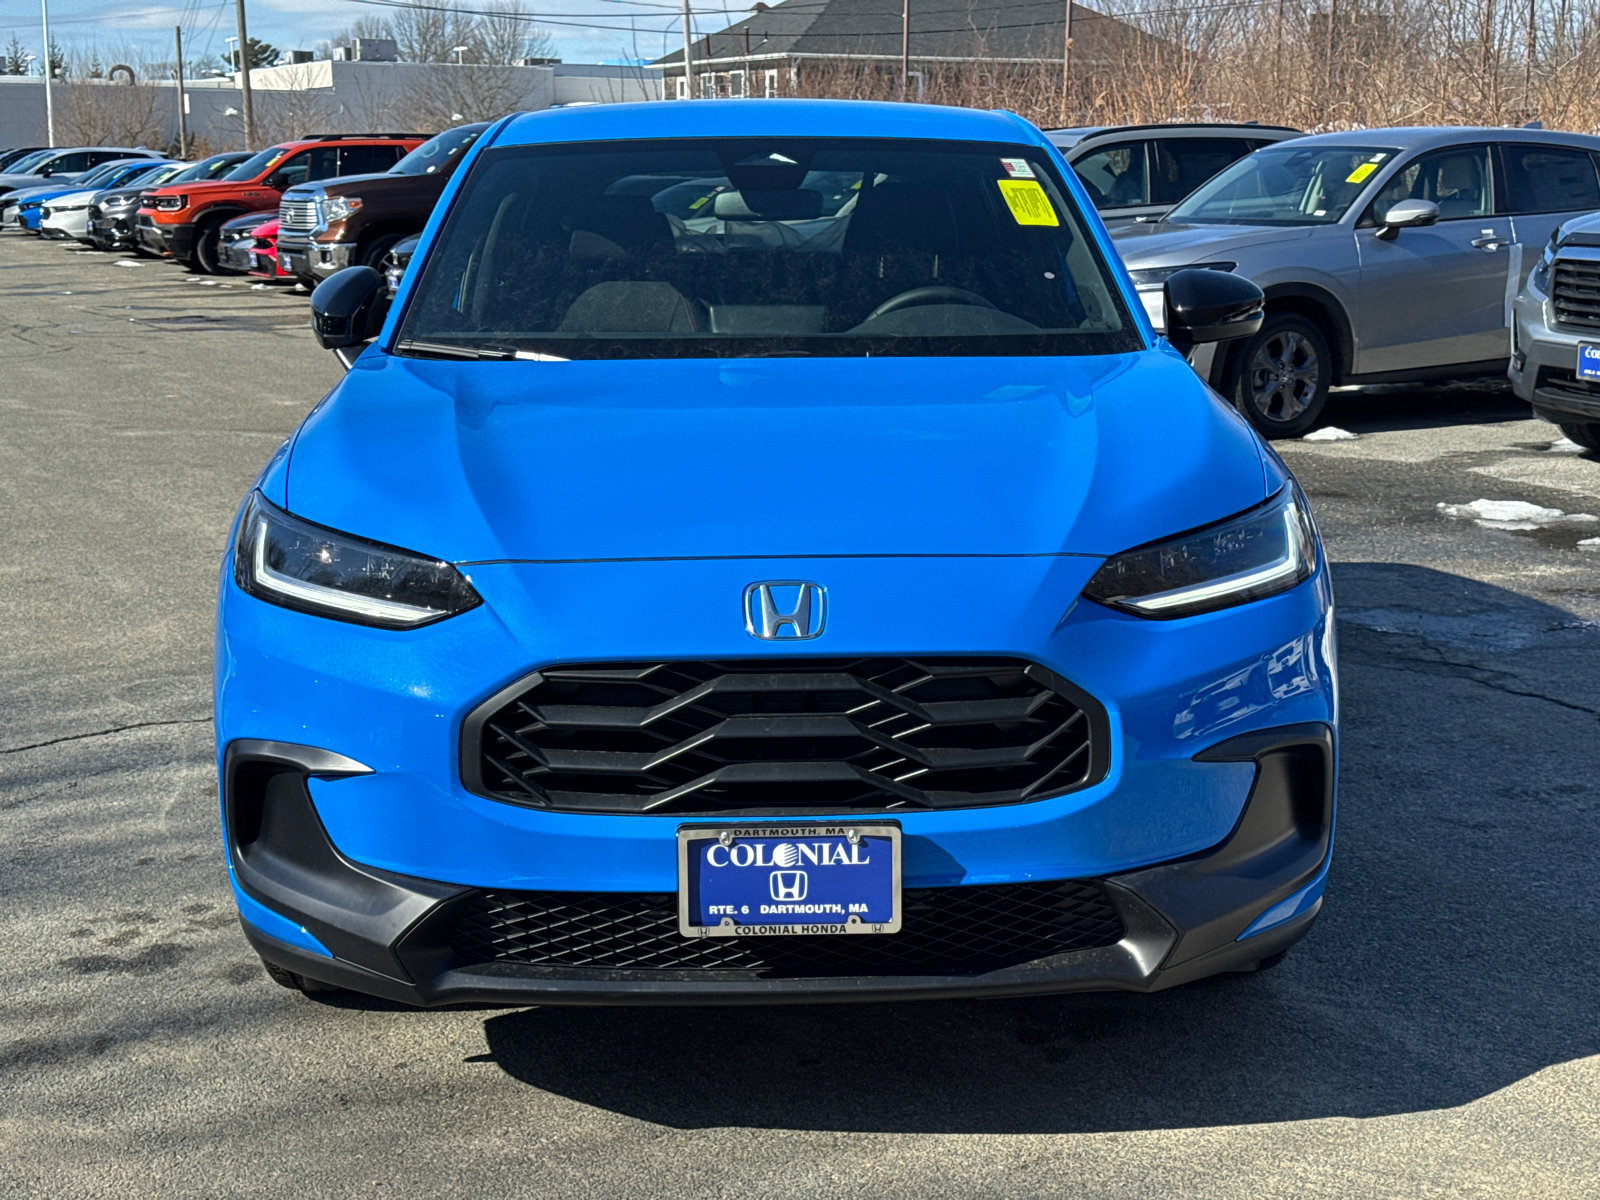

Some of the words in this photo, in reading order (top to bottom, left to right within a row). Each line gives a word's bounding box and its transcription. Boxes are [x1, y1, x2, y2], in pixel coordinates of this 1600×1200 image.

[825, 827, 845, 835] MA
[706, 842, 870, 868] COLONIAL
[708, 905, 738, 915] RTE.
[740, 905, 750, 915] 6
[760, 903, 846, 915] DARTMOUTH,
[849, 903, 869, 913] MA
[734, 925, 798, 935] COLONIAL
[801, 924, 847, 934] HONDA
